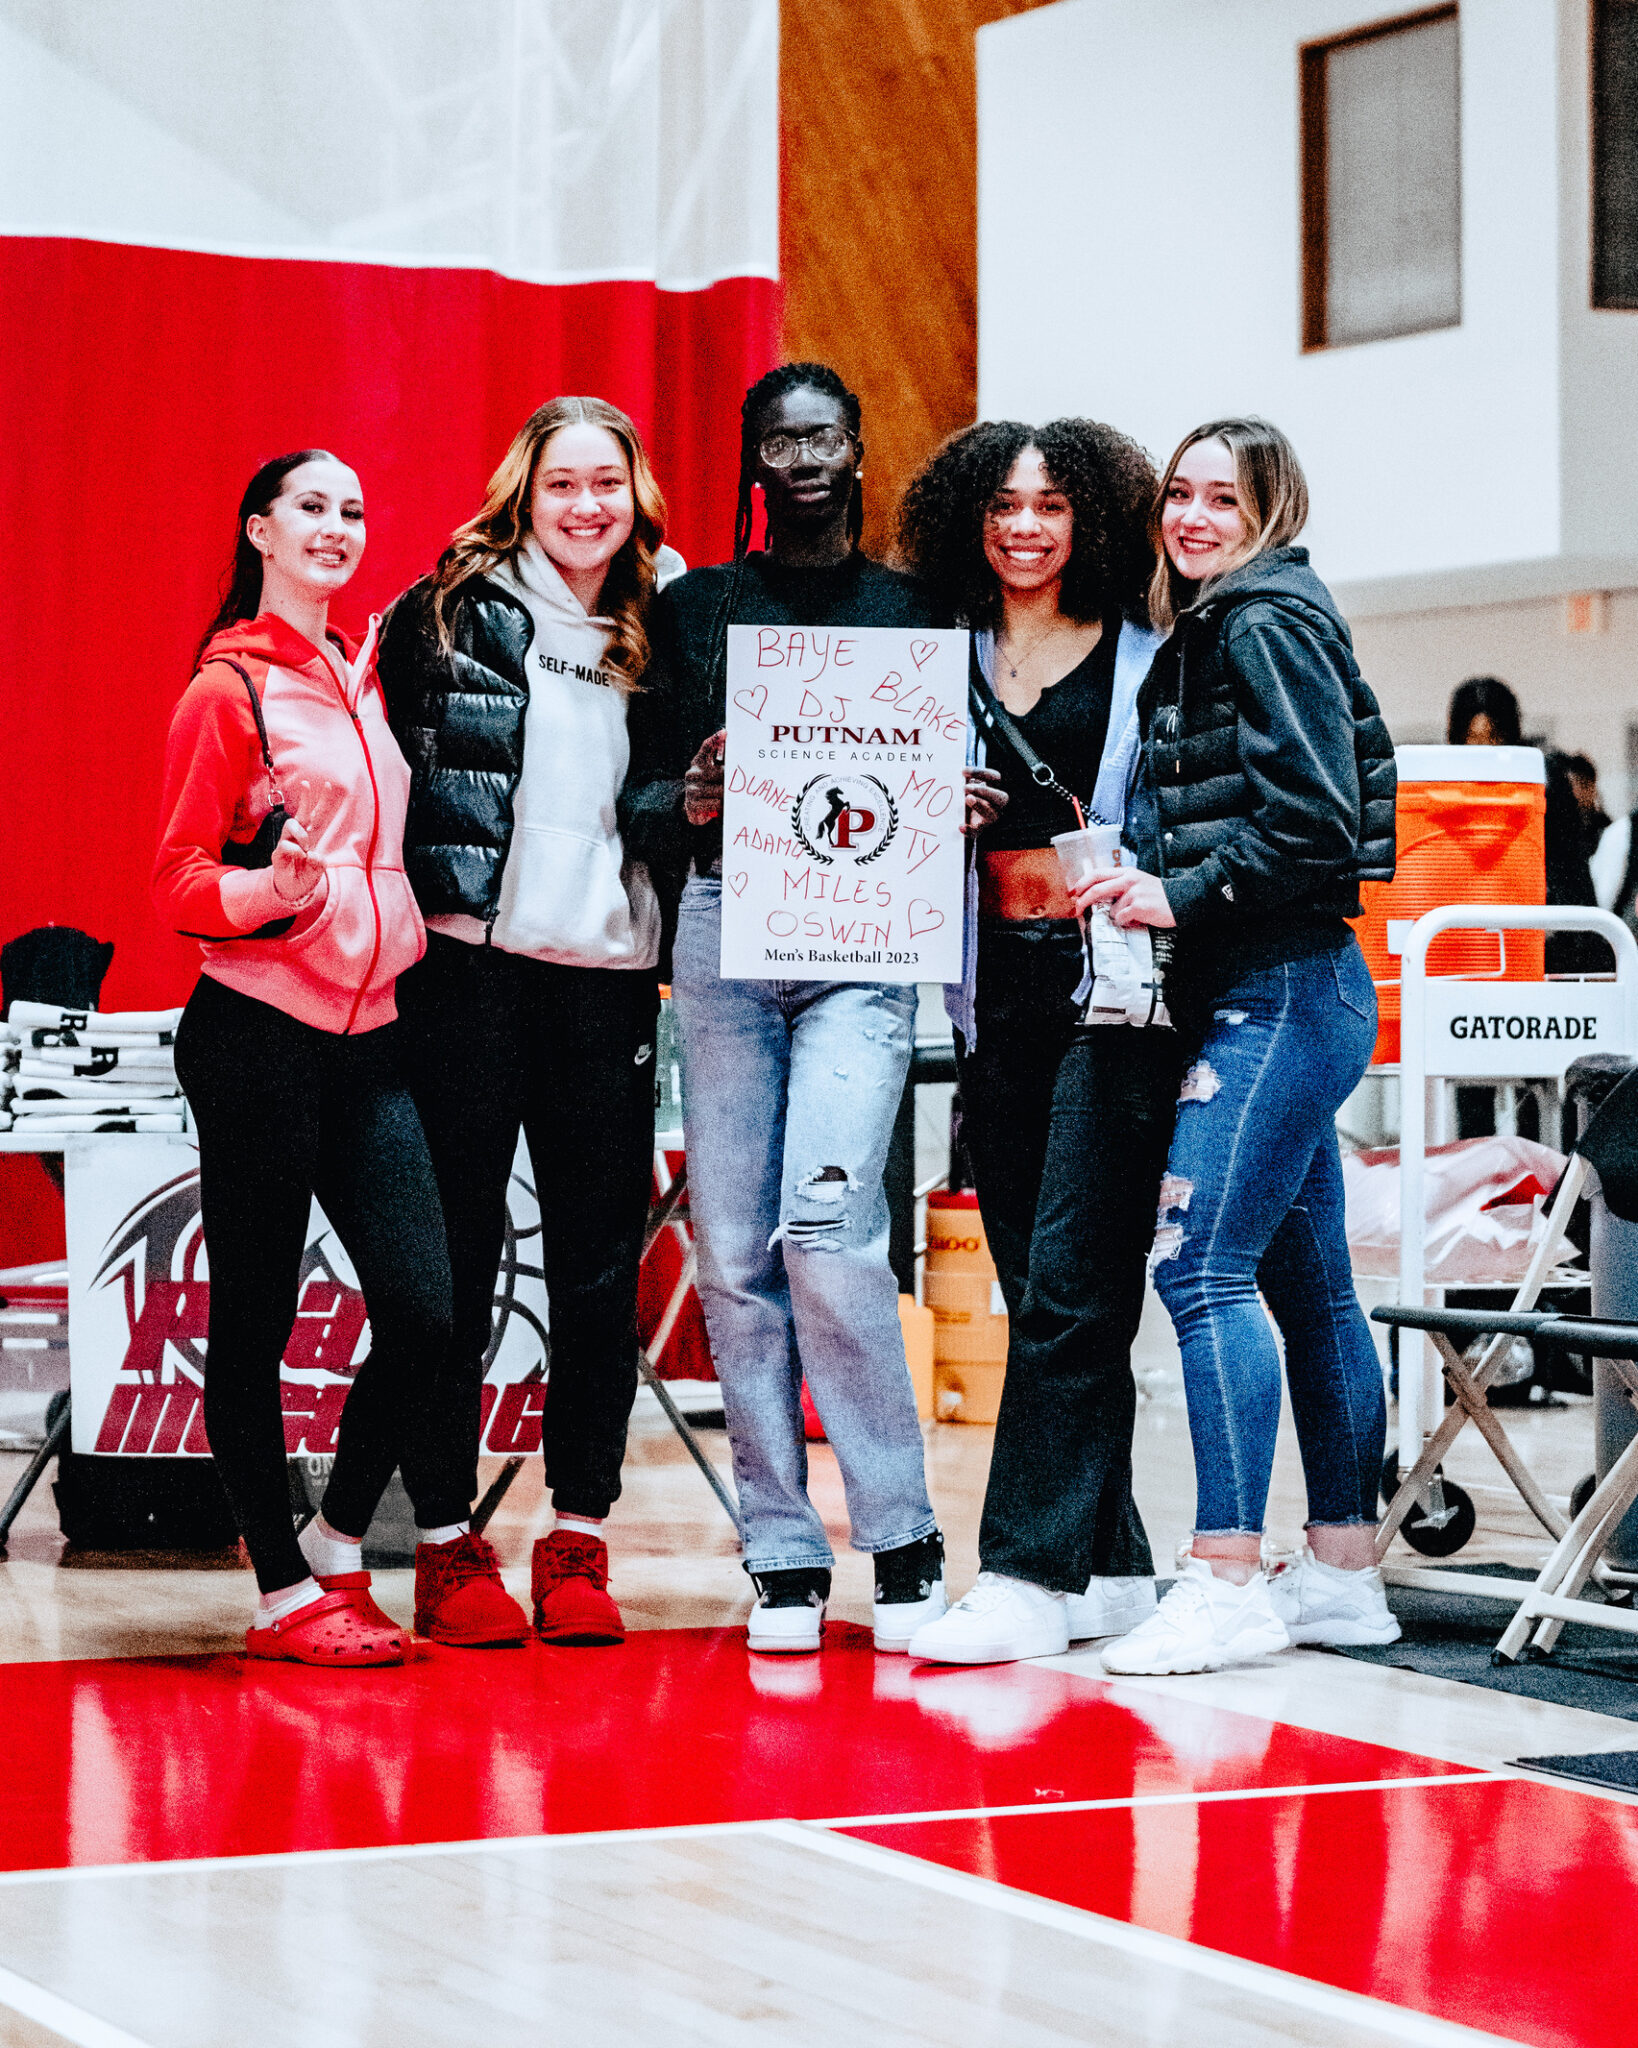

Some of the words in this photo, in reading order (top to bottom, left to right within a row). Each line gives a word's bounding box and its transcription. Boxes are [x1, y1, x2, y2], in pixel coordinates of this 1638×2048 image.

[538, 654, 610, 687] SELF-MADE
[758, 627, 859, 682] BAYE
[799, 689, 852, 723] DJ
[870, 671, 967, 741] BLAKE
[771, 724, 922, 746] PUTNAM
[758, 749, 836, 760] SCIENCE
[850, 751, 934, 763] ACADEMY
[728, 764, 797, 812] DUANE
[899, 770, 953, 817] MO
[830, 808, 876, 849] P
[902, 825, 941, 875] TY
[783, 866, 892, 908] MILES
[766, 910, 892, 948] OSWIN
[808, 949, 882, 964] Basketball
[886, 952, 919, 964] 2023
[1449, 1016, 1597, 1040] GATORADE
